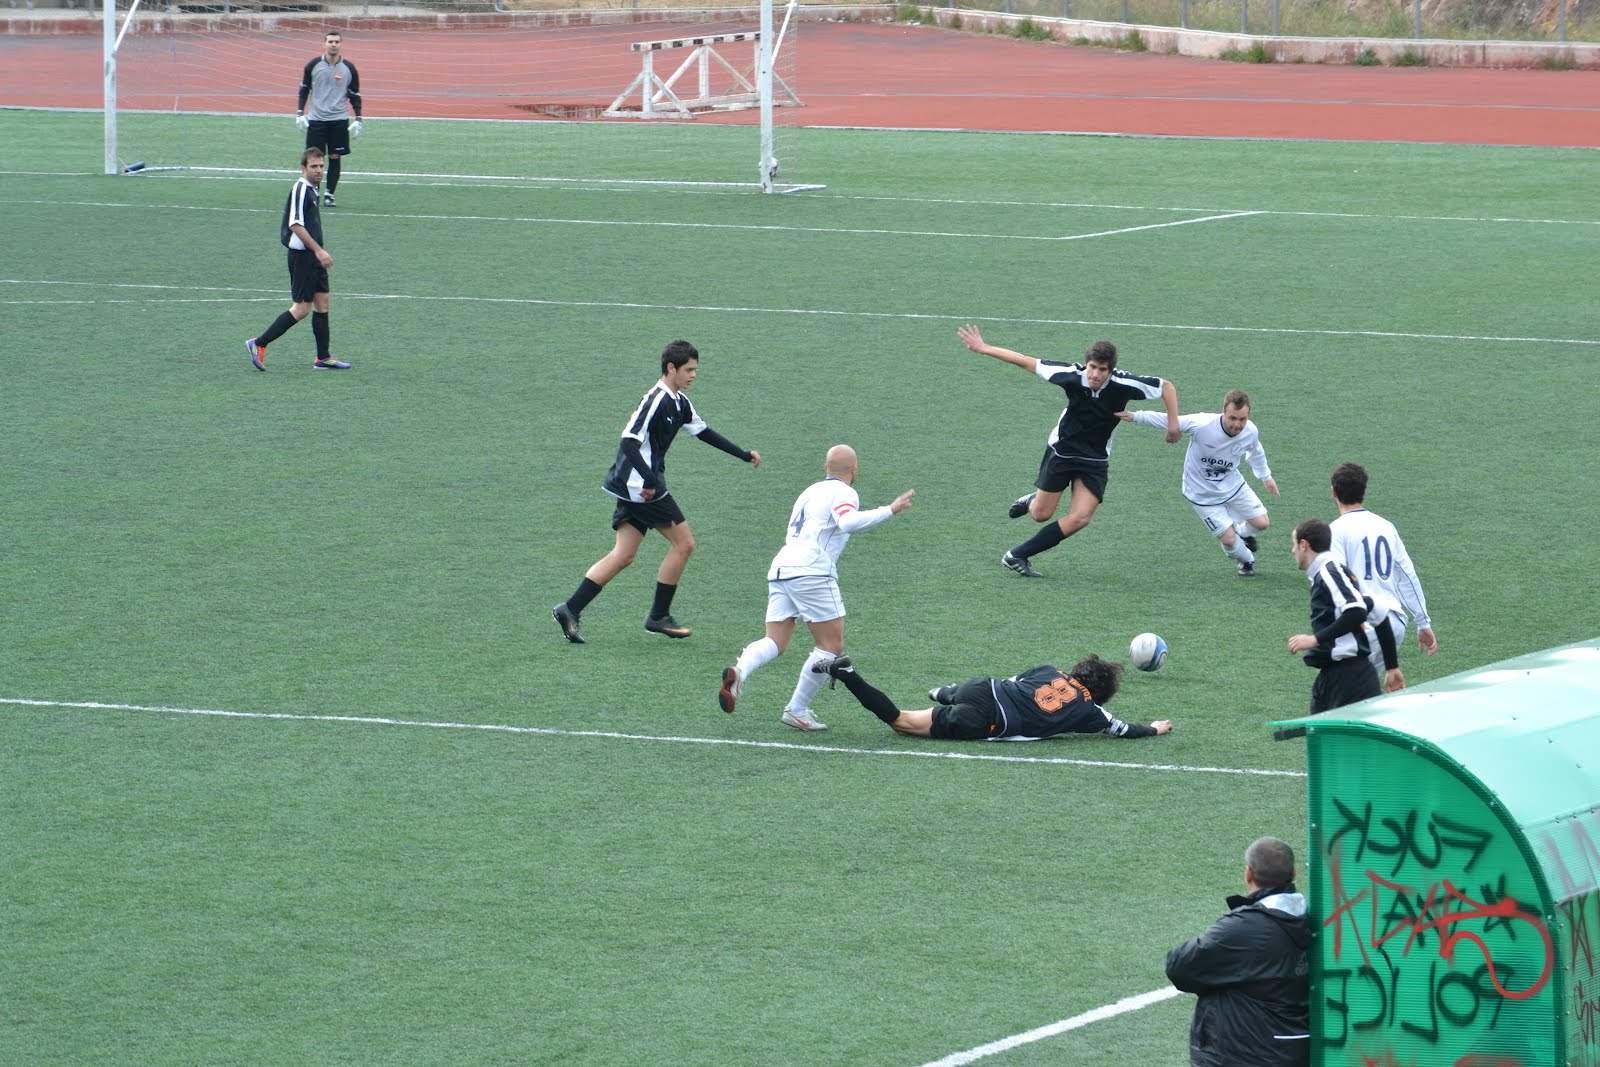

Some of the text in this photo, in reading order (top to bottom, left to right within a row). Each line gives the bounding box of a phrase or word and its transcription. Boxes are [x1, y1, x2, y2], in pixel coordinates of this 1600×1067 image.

[790, 506, 807, 537] 4
[1204, 517, 1218, 531] 11
[1361, 535, 1392, 580] 10
[1034, 677, 1077, 713] 8
